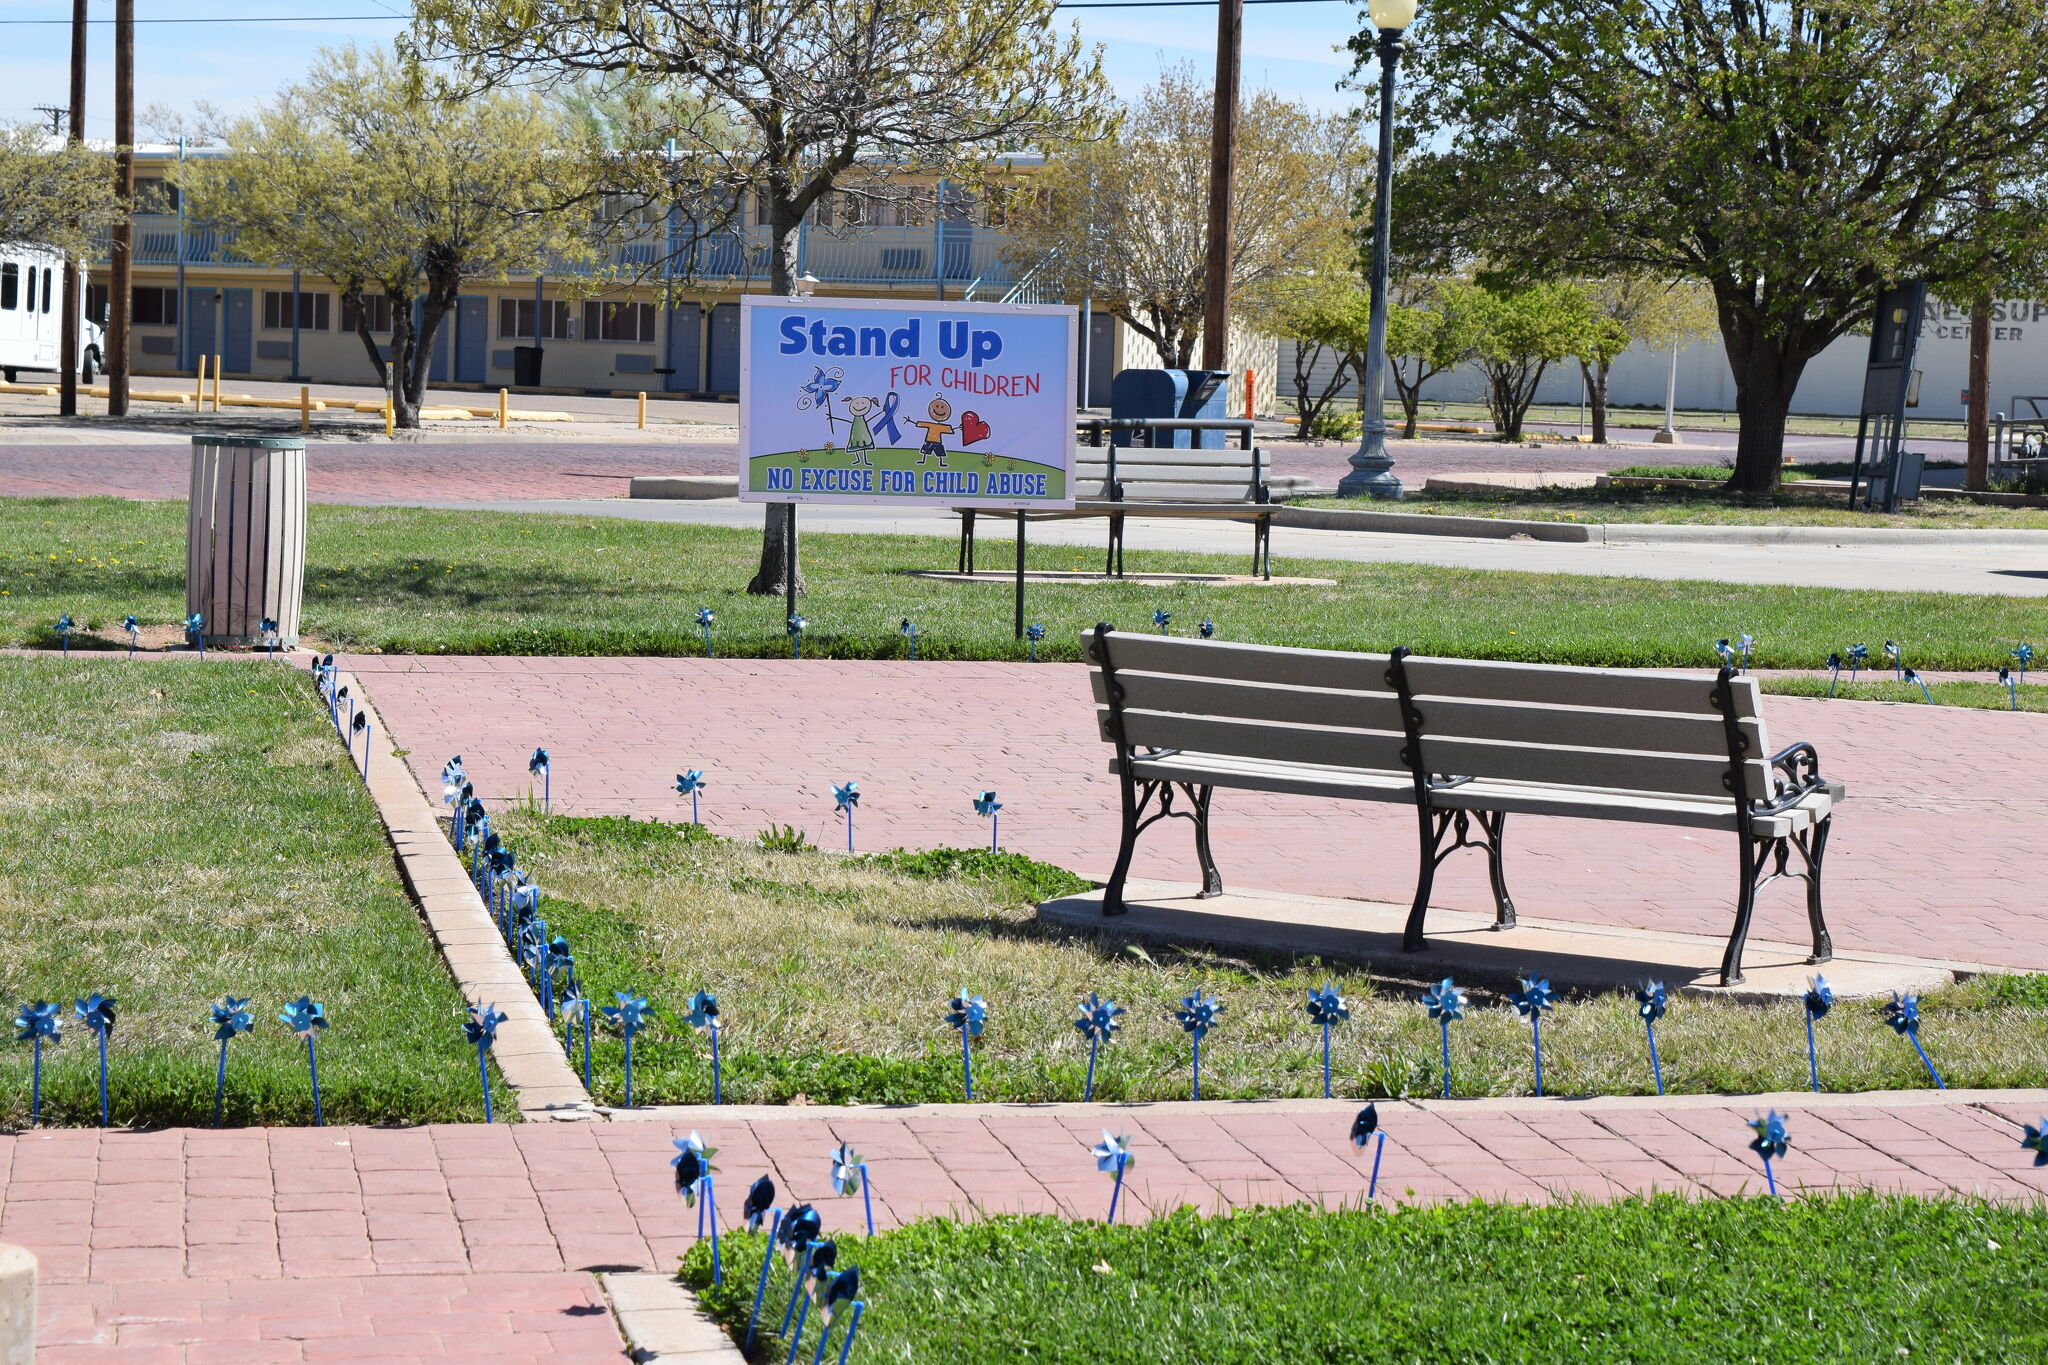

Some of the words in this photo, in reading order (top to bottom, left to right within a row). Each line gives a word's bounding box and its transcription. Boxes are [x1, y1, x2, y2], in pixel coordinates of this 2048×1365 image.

[779, 315, 920, 358] Stand
[938, 320, 1003, 368] Up
[1937, 326, 2023, 341] CEER
[890, 364, 932, 388] FOR
[941, 367, 1040, 397] CHILDREN
[767, 467, 793, 490] NO
[800, 468, 873, 492] EXCUSE
[880, 470, 916, 493] FOR
[923, 471, 979, 494] CHILD
[985, 472, 1046, 496] ABUSE
